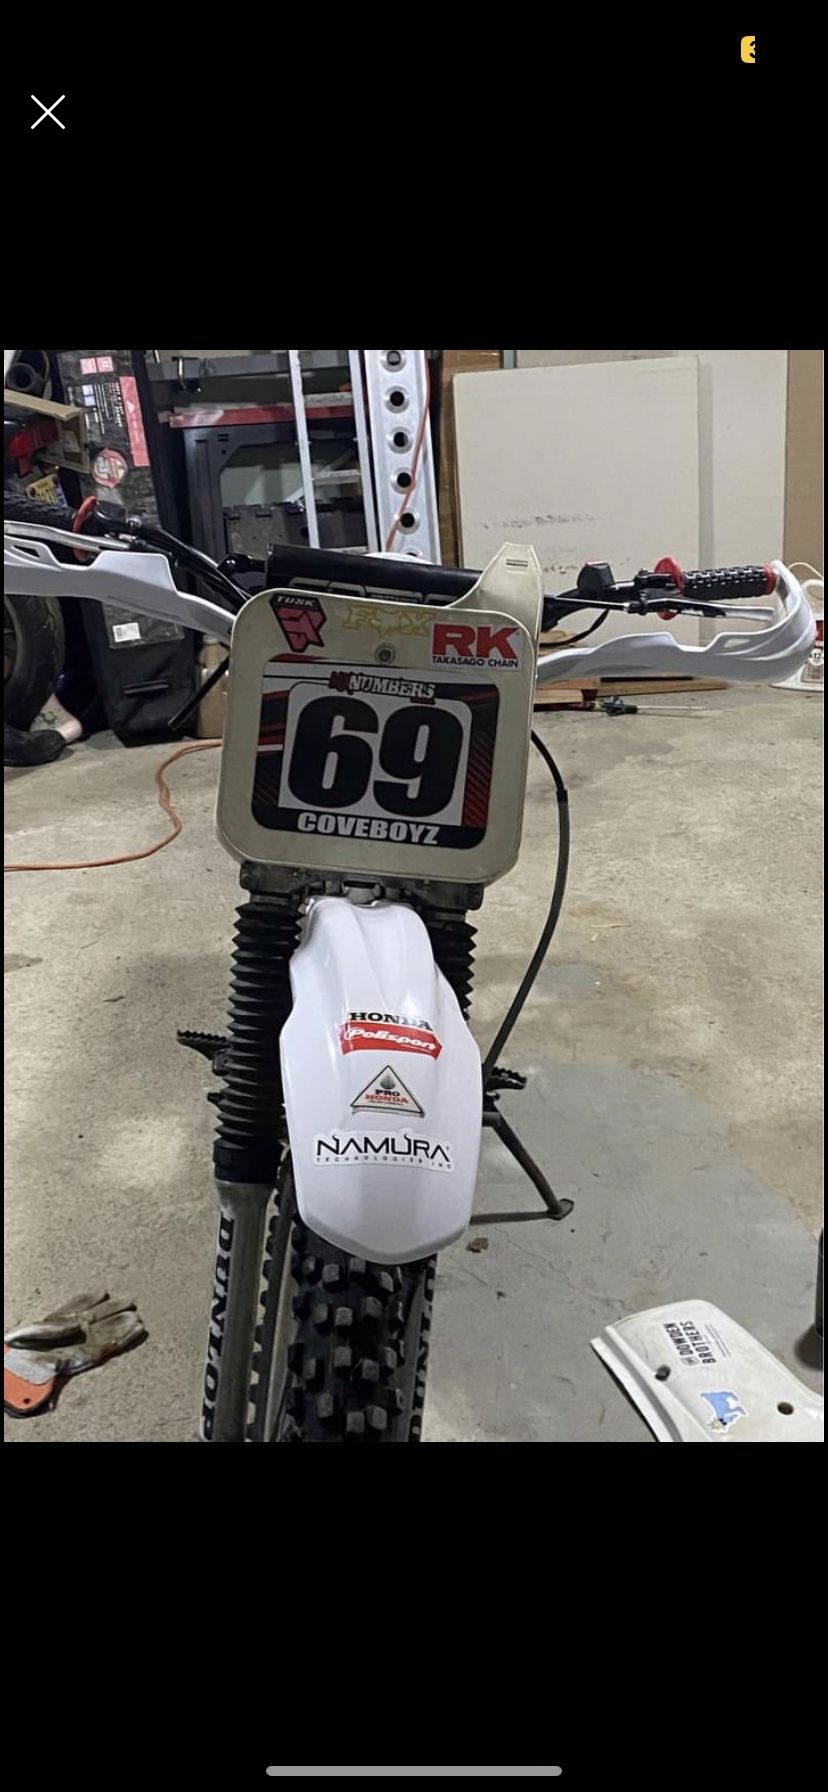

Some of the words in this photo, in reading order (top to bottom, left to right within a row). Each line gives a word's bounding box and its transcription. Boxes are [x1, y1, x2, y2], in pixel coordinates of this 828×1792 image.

[276, 595, 317, 607] TUSK
[432, 624, 519, 660] RK
[432, 655, 484, 667] TAKASAGO
[488, 658, 519, 668] CHAIN
[288, 695, 465, 818] 69
[297, 812, 440, 845] COVEBOYZ
[350, 1012, 433, 1031] HONDA
[365, 1094, 409, 1104] HONDA
[374, 1089, 400, 1097] PRO
[316, 1133, 451, 1162] NAMURA
[316, 1155, 423, 1164] TECHNOLOGIES
[431, 1161, 452, 1169] INC
[203, 1212, 235, 1441] DUNLOP
[663, 1322, 694, 1356] DOWDEN
[680, 1320, 717, 1364] BROTHERS
